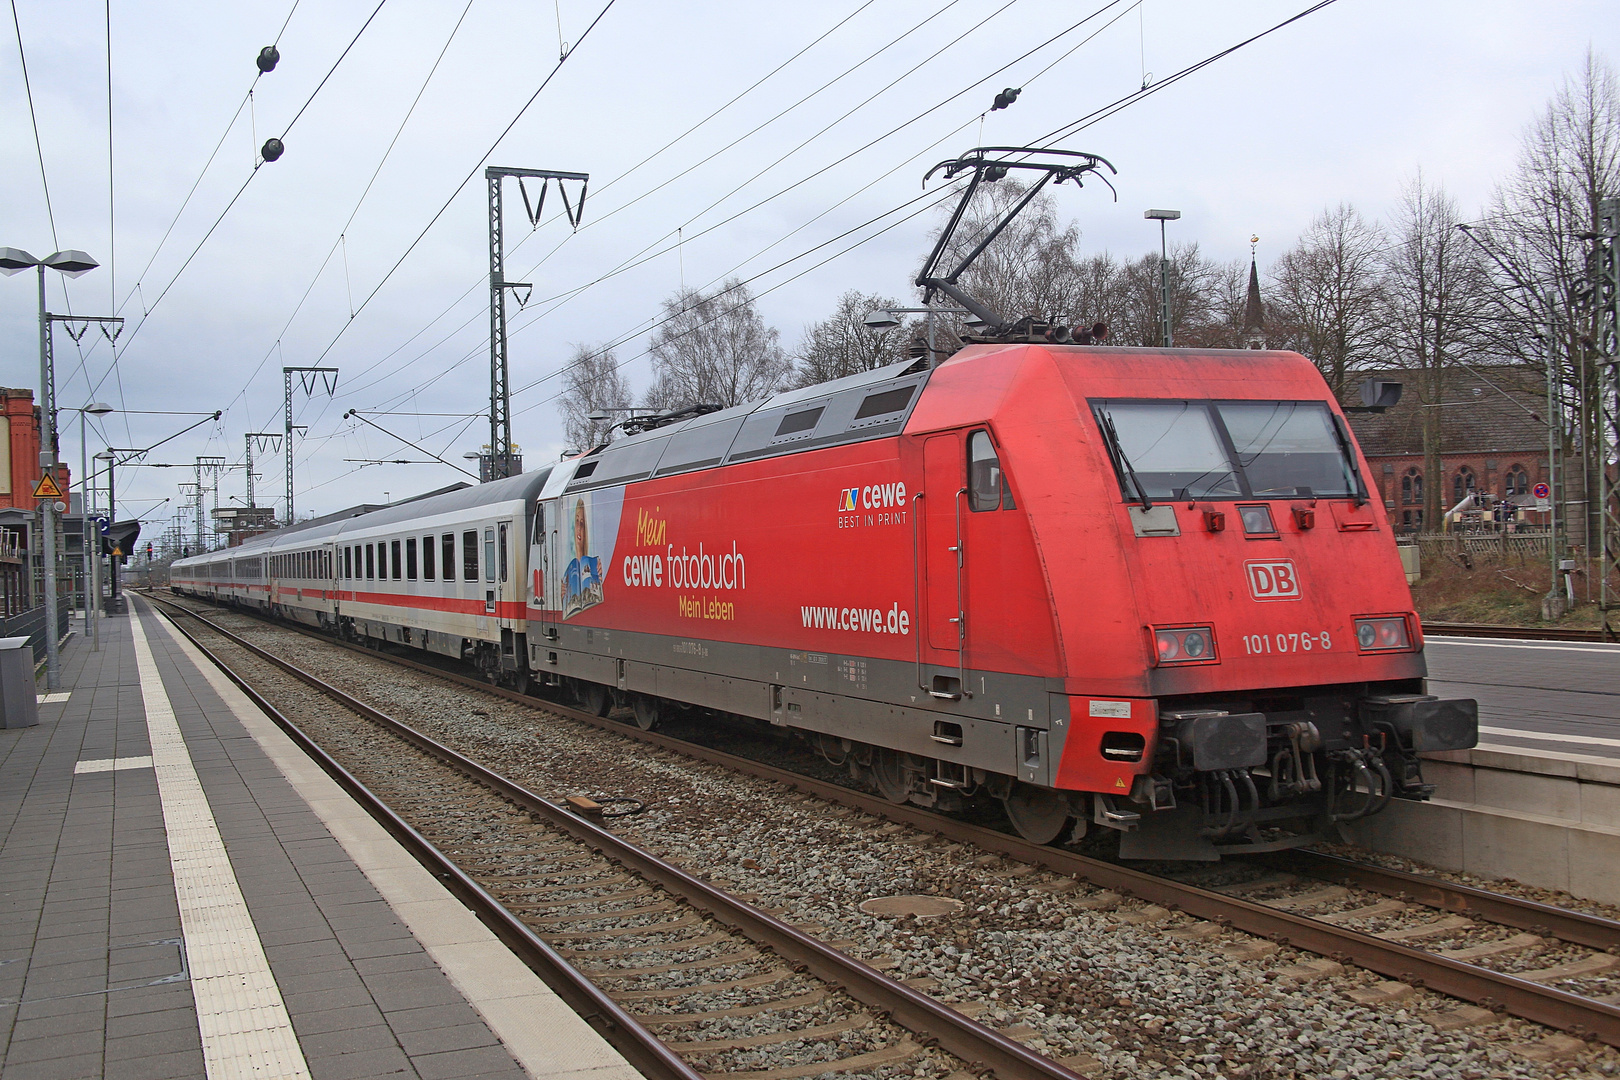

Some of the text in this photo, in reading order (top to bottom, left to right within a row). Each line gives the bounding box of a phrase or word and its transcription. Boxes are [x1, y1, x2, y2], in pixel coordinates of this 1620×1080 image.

[862, 481, 907, 510] cewe
[636, 506, 666, 547] Mein
[838, 511, 907, 529] BEST IN PRINT
[623, 540, 746, 589] cewe fotobuch
[1251, 565, 1295, 594] DB
[679, 594, 735, 621] Mein Leben
[800, 601, 910, 635] www.cewe.de
[1242, 630, 1332, 655] 101 076-8
